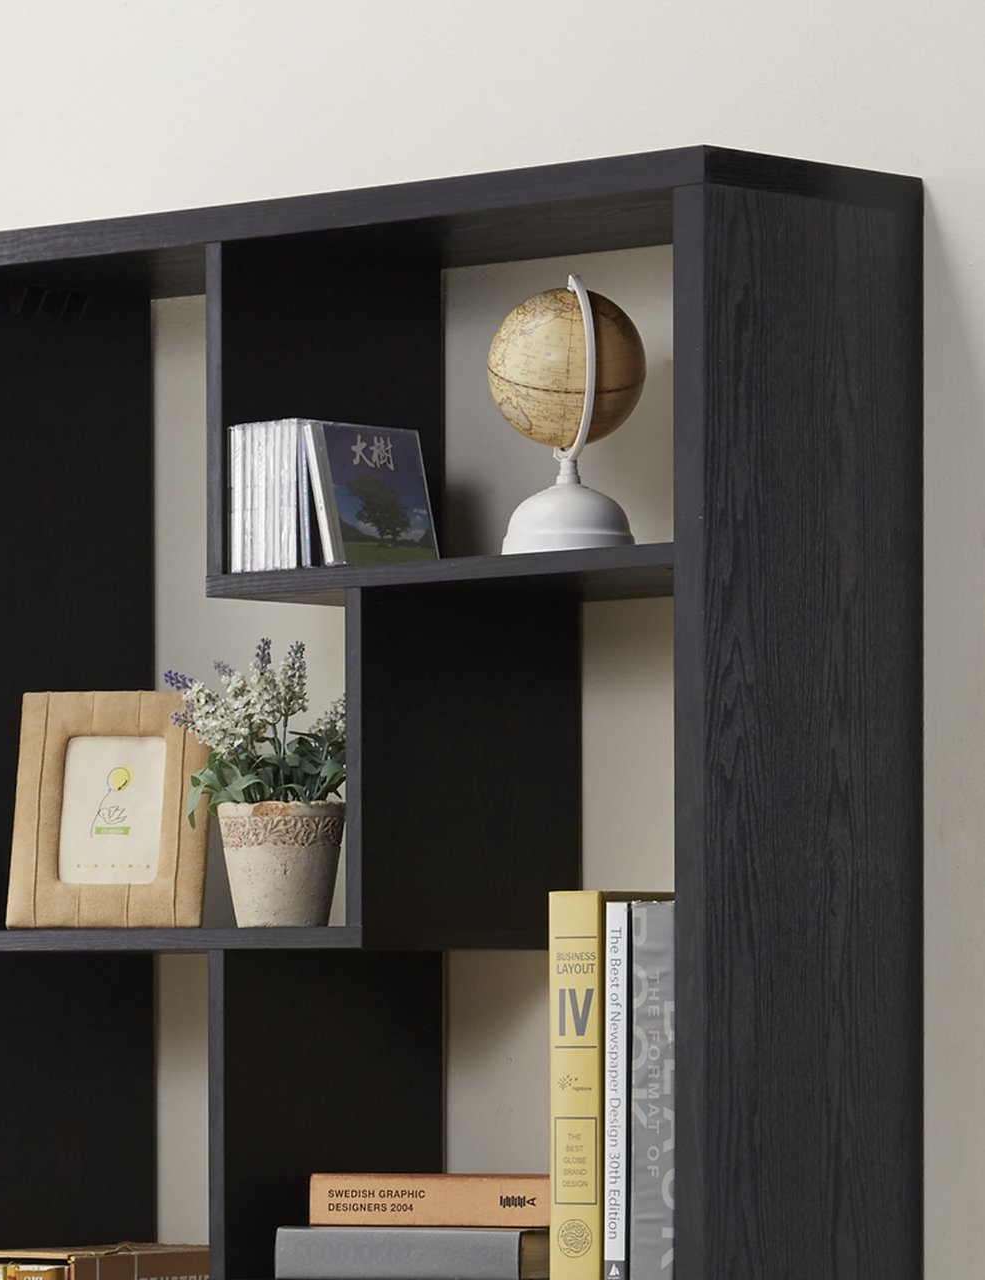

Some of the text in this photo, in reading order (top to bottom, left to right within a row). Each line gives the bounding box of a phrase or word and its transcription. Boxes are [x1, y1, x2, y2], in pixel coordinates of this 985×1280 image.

[351, 434, 394, 471] 大樹
[556, 952, 596, 961] BUSINESS
[556, 963, 596, 975] LAYOUT
[558, 988, 595, 1036] IV
[607, 926, 622, 1240] The Best of Newspaper Design 30th Edition
[647, 971, 660, 1183] THE FORMAT OF
[328, 1189, 426, 1199] SWEDISH GRAPHIC
[328, 1203, 414, 1212] DESIGNERS 2004
